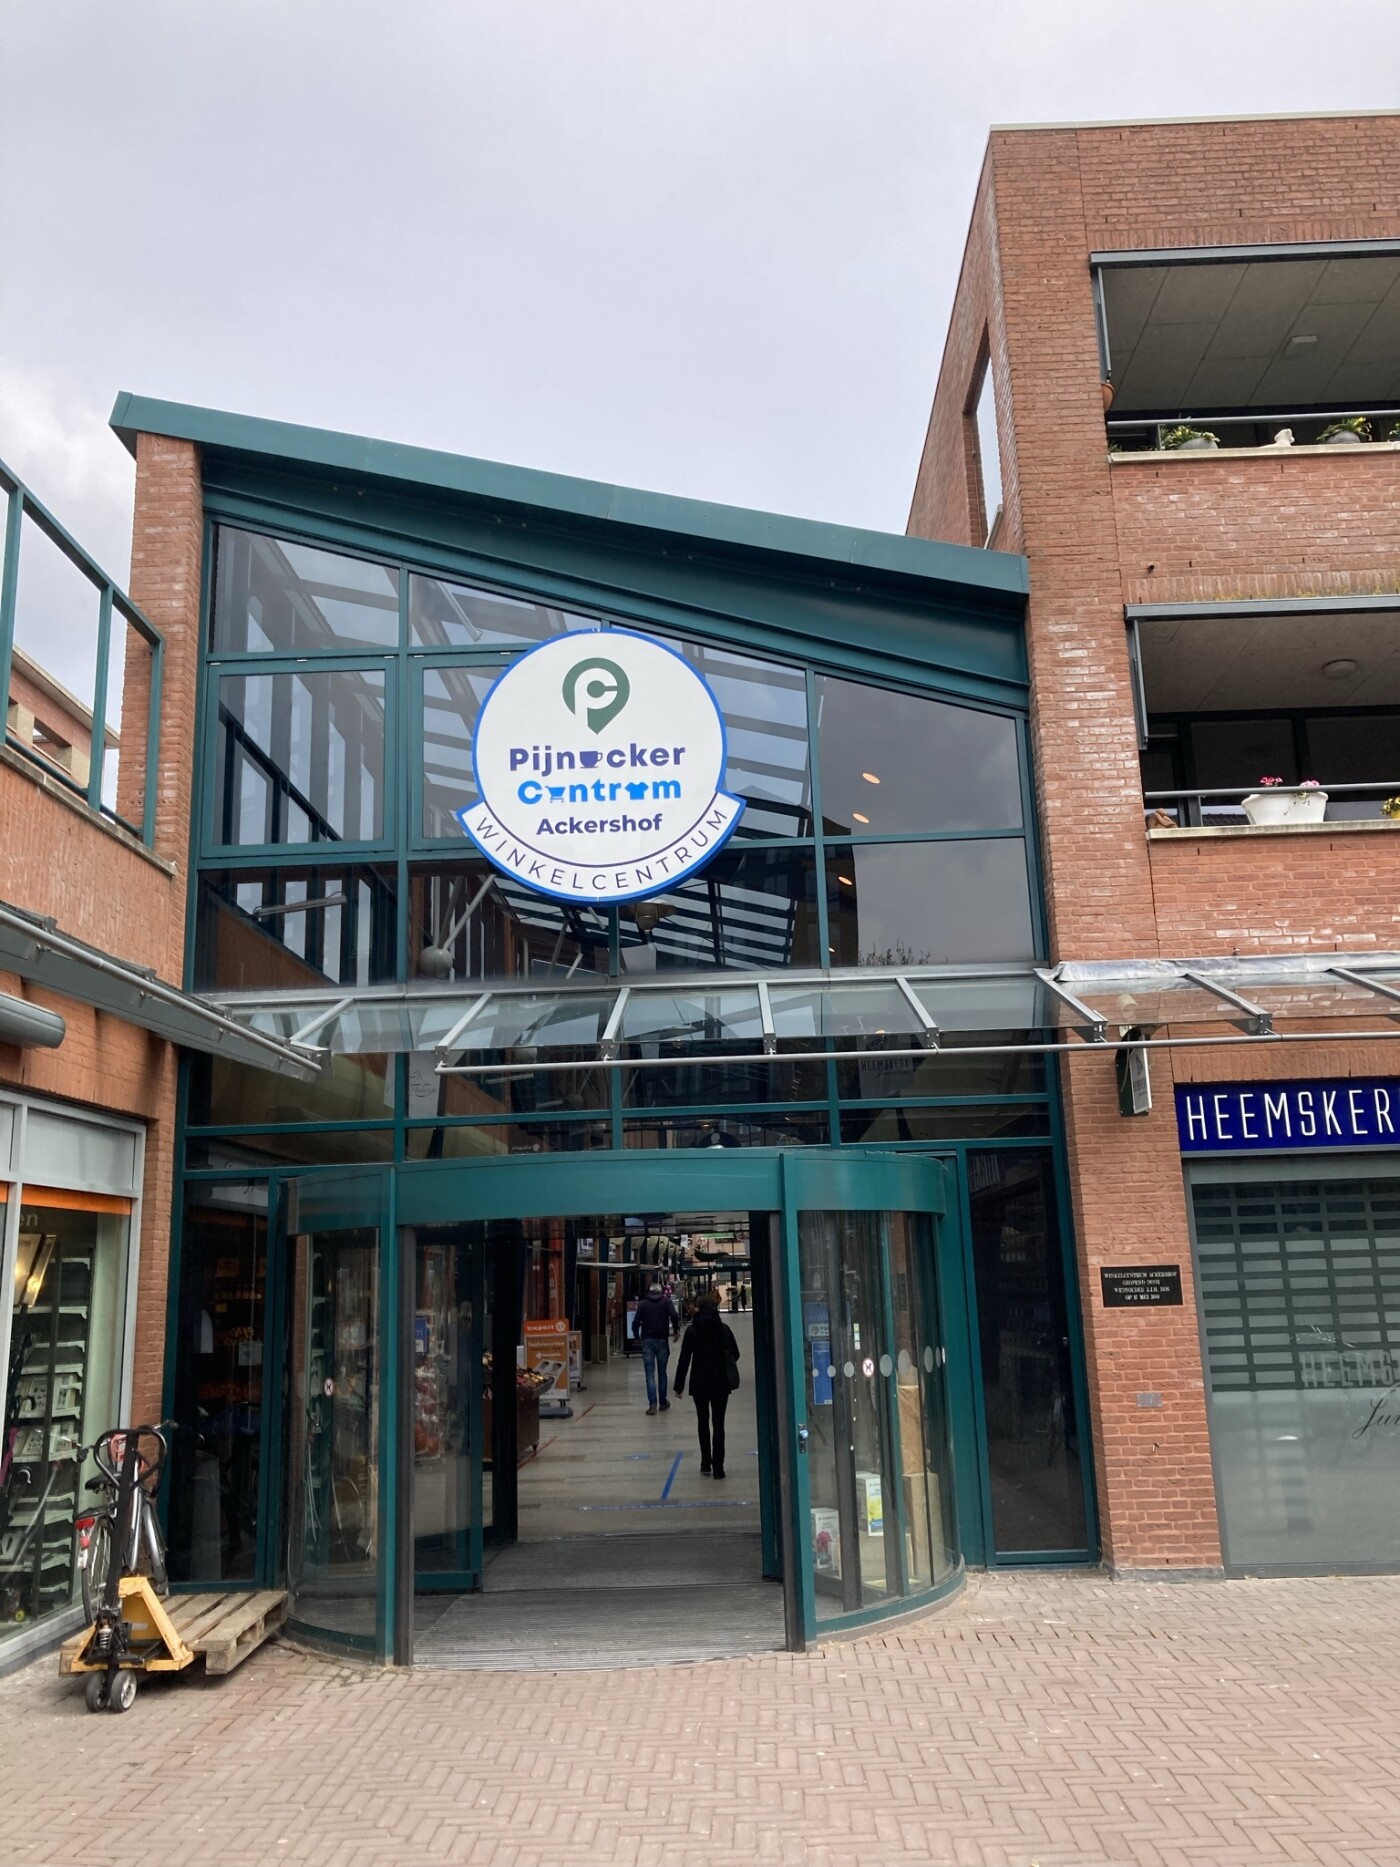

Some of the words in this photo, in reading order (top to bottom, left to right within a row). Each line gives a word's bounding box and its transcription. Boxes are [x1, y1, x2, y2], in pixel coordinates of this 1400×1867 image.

[510, 743, 685, 776] Pijncker
[517, 778, 681, 804] Cntrm
[536, 813, 663, 835] Ackershof
[476, 808, 728, 890] WINKELCENTRUM
[1186, 1088, 1396, 1141] HEEMSKER
